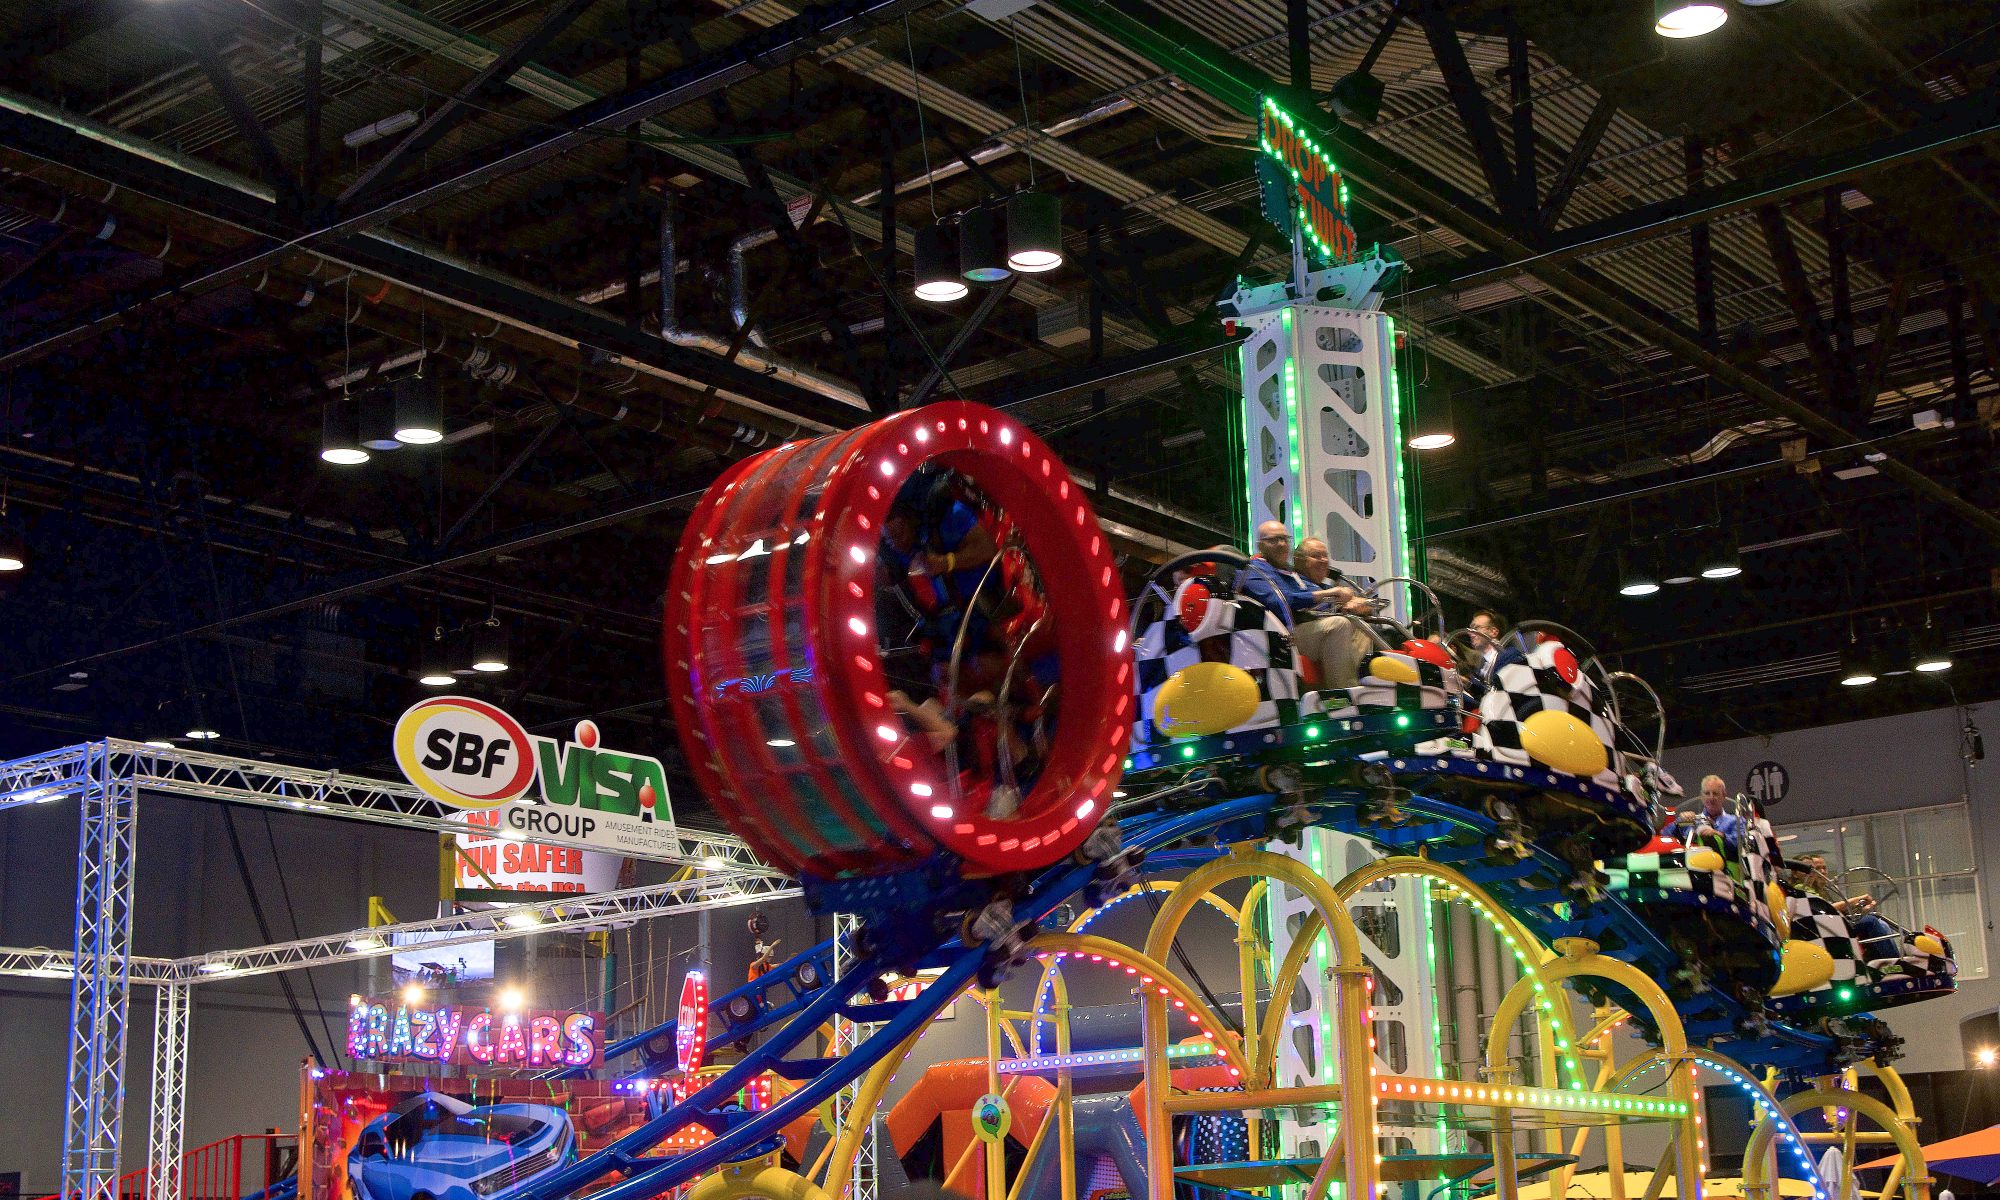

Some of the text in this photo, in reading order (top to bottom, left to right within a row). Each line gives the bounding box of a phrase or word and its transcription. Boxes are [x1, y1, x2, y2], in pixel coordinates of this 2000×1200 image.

[1297, 183, 1354, 264] TWIST
[421, 728, 511, 779] SBF
[538, 723, 671, 822] VISA
[508, 806, 596, 839] GROUP
[605, 820, 676, 839] AMUSEMENT RIDES
[616, 835, 677, 851] MANUFACTURER
[503, 843, 583, 876] SAFER
[466, 1012, 596, 1068] CARS
